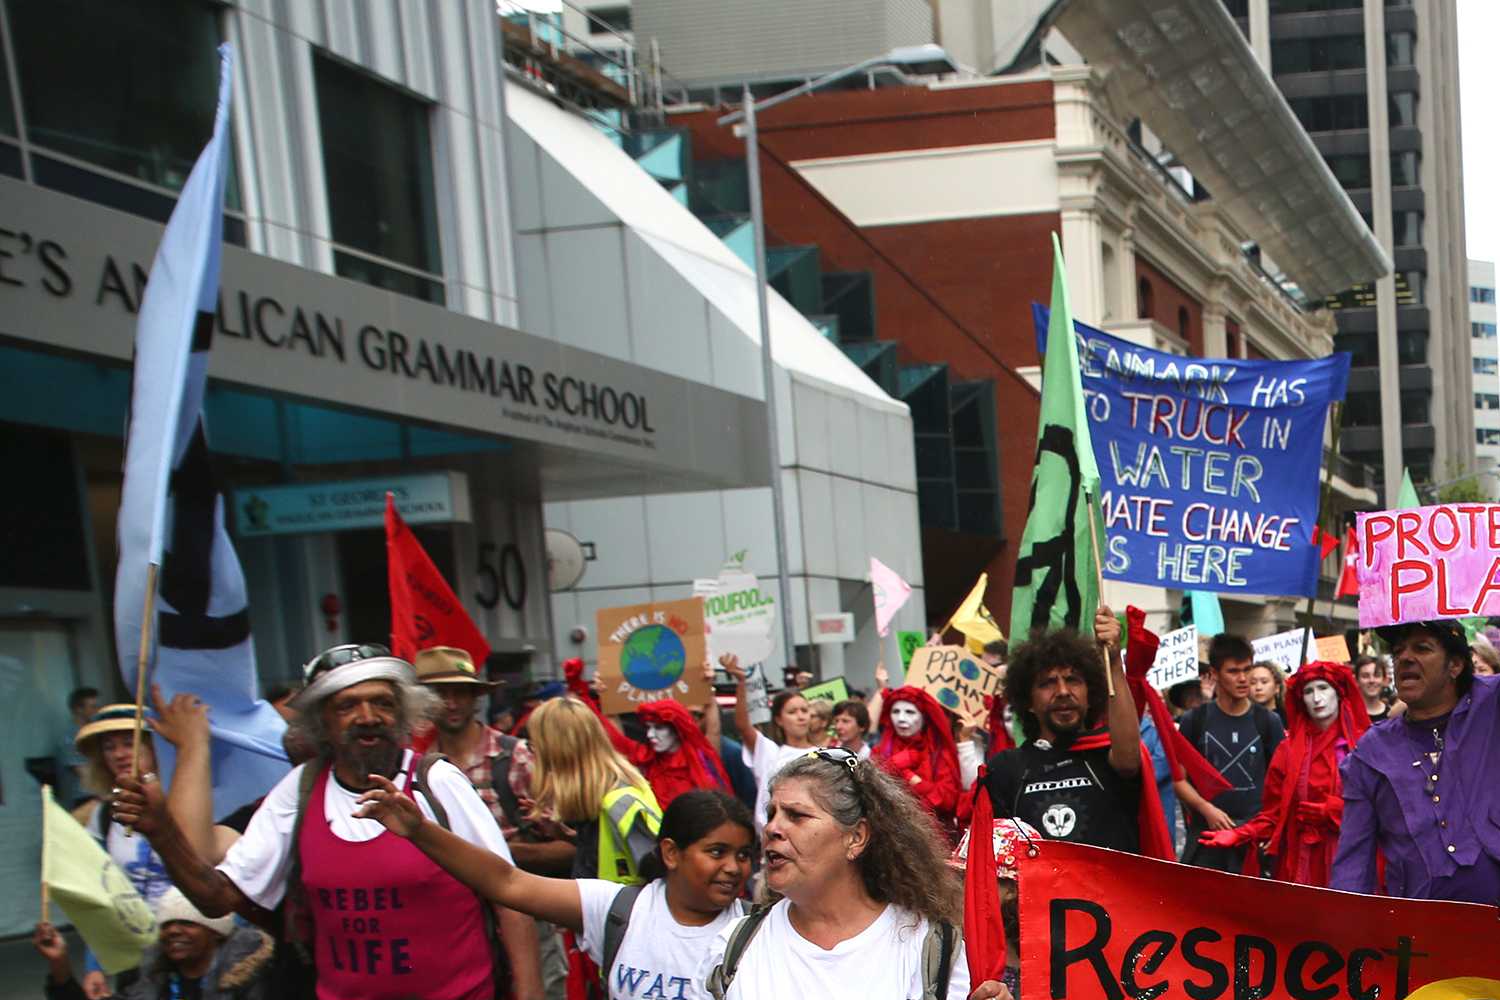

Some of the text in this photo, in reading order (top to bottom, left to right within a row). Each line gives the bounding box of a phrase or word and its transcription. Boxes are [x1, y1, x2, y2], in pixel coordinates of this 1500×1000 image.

[95, 253, 345, 363] ALICAN
[357, 323, 538, 407] GRAMMAR
[543, 372, 656, 433] SCHOOL
[1250, 375, 1307, 409] HAS
[1120, 392, 1250, 449] TRUCK
[1261, 416, 1292, 451] IN
[1108, 439, 1264, 504] WATER
[1100, 490, 1300, 551] MATE CHANGE
[475, 542, 527, 611] 50
[1104, 534, 1253, 587] S HERE
[608, 611, 689, 643] THERE IS NO
[1172, 627, 1195, 646] NOT
[1152, 656, 1197, 686] THER
[617, 679, 689, 702] PLANET B
[318, 887, 405, 911] REBEL
[341, 917, 382, 935] FOR
[329, 935, 414, 976] LIFE
